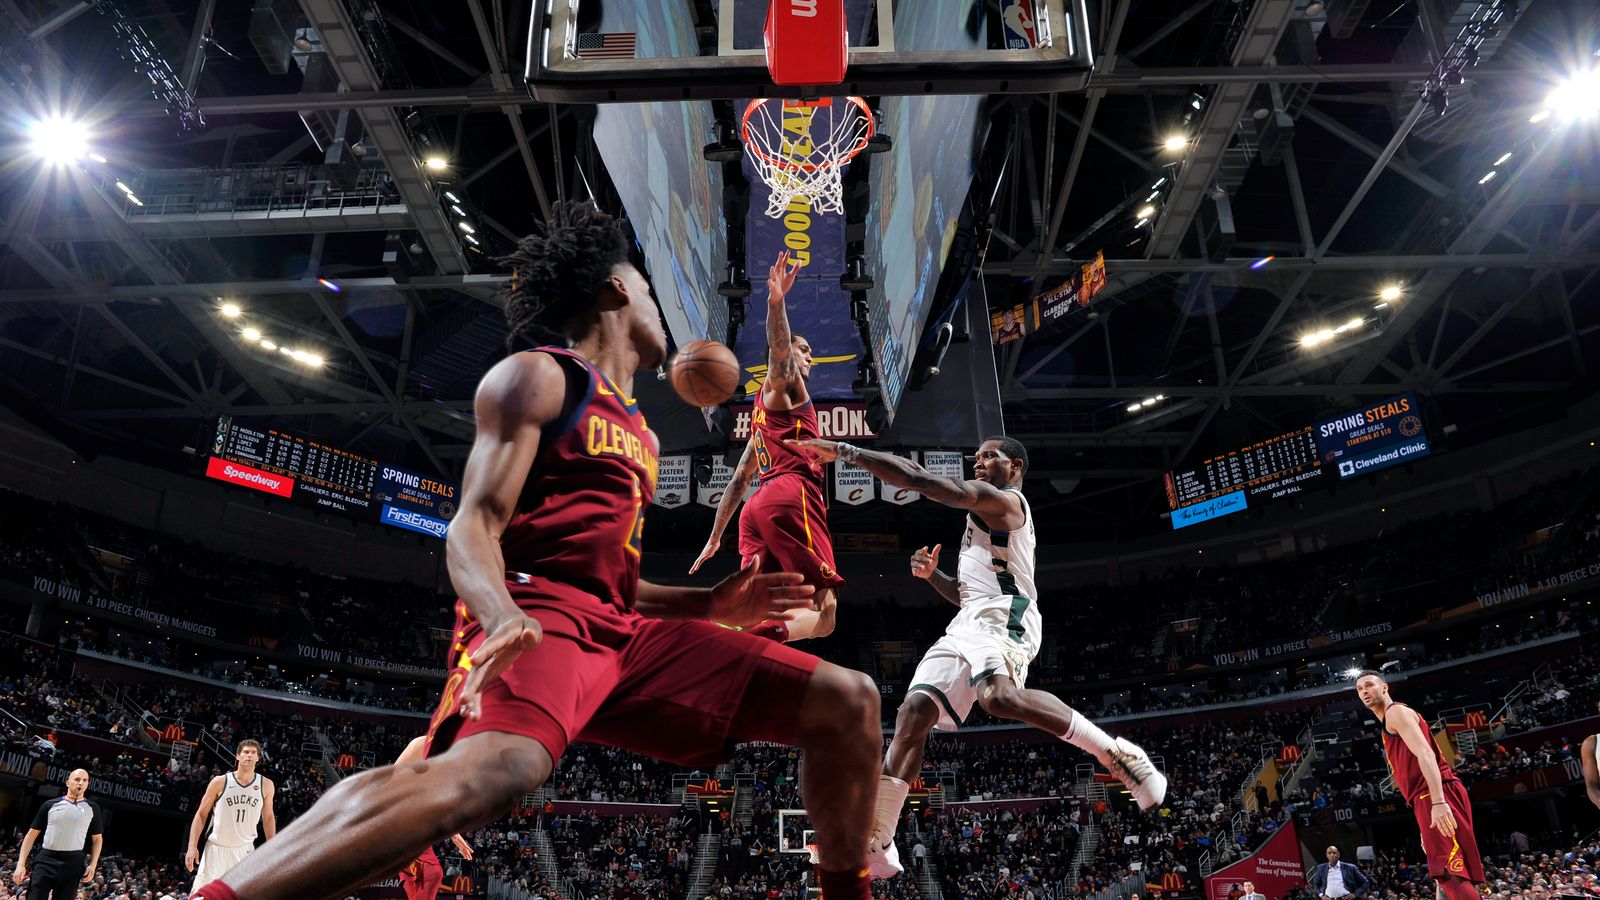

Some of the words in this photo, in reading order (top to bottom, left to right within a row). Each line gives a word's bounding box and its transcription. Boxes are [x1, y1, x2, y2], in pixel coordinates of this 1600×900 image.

[1010, 39, 1026, 48] NBA
[1048, 286, 1072, 304] ALL-STAR
[1053, 305, 1069, 319] CREW
[1320, 413, 1365, 438] SPRING
[1366, 398, 1410, 423] STEALS
[240, 427, 265, 439] MIDDLETON
[1349, 429, 1366, 438] GREAT
[1367, 422, 1385, 433] DEALS
[237, 439, 253, 447] LOPEZ
[1346, 435, 1372, 447] STARTING
[1355, 450, 1398, 469] Cleveland
[1399, 442, 1426, 456] Clinic
[223, 465, 280, 490] Speedway
[382, 468, 420, 488] SPRING
[420, 479, 454, 498] STEALS
[1282, 477, 1295, 486] ERIC
[1296, 469, 1322, 481] BLEDSOE
[402, 488, 417, 497] GREAT
[417, 492, 431, 500] DEALS
[1272, 490, 1286, 498] JUMP
[345, 496, 369, 508] BLEDSOE
[1209, 503, 1216, 514] of
[388, 506, 448, 534] FirstEnergy
[1476, 591, 1501, 608] YOU
[1503, 582, 1530, 600] WIN
[1536, 580, 1544, 590] A
[1546, 577, 1558, 588] 10
[1559, 567, 1589, 584] PIECE
[33, 575, 56, 595] YOU
[57, 583, 81, 604] WIN
[86, 594, 94, 605] A
[96, 597, 107, 609] 10
[108, 600, 133, 616] PIECE
[134, 608, 170, 625] CHICKEN
[170, 617, 217, 637] McNUGGETS
[1213, 653, 1235, 666] YOU
[1264, 649, 1270, 657] A
[1272, 646, 1281, 655] 10
[1283, 640, 1305, 653] PIECE
[1343, 622, 1392, 641] McNUGGETS
[297, 643, 318, 659] YOU
[320, 649, 342, 663] WIN
[346, 655, 353, 664] A
[354, 657, 364, 666] 10
[365, 658, 387, 670] PIECE
[387, 662, 420, 674] CHICKEN
[881, 684, 893, 694] 95
[7, 752, 32, 776] WIN
[114, 783, 162, 807] McNUGGETS
[226, 794, 259, 808] BUCKS
[236, 809, 245, 822] 11
[1334, 808, 1353, 822] 100
[1268, 859, 1300, 868] Convenience
[1256, 867, 1272, 875] Stores
[1274, 868, 1279, 877] of
